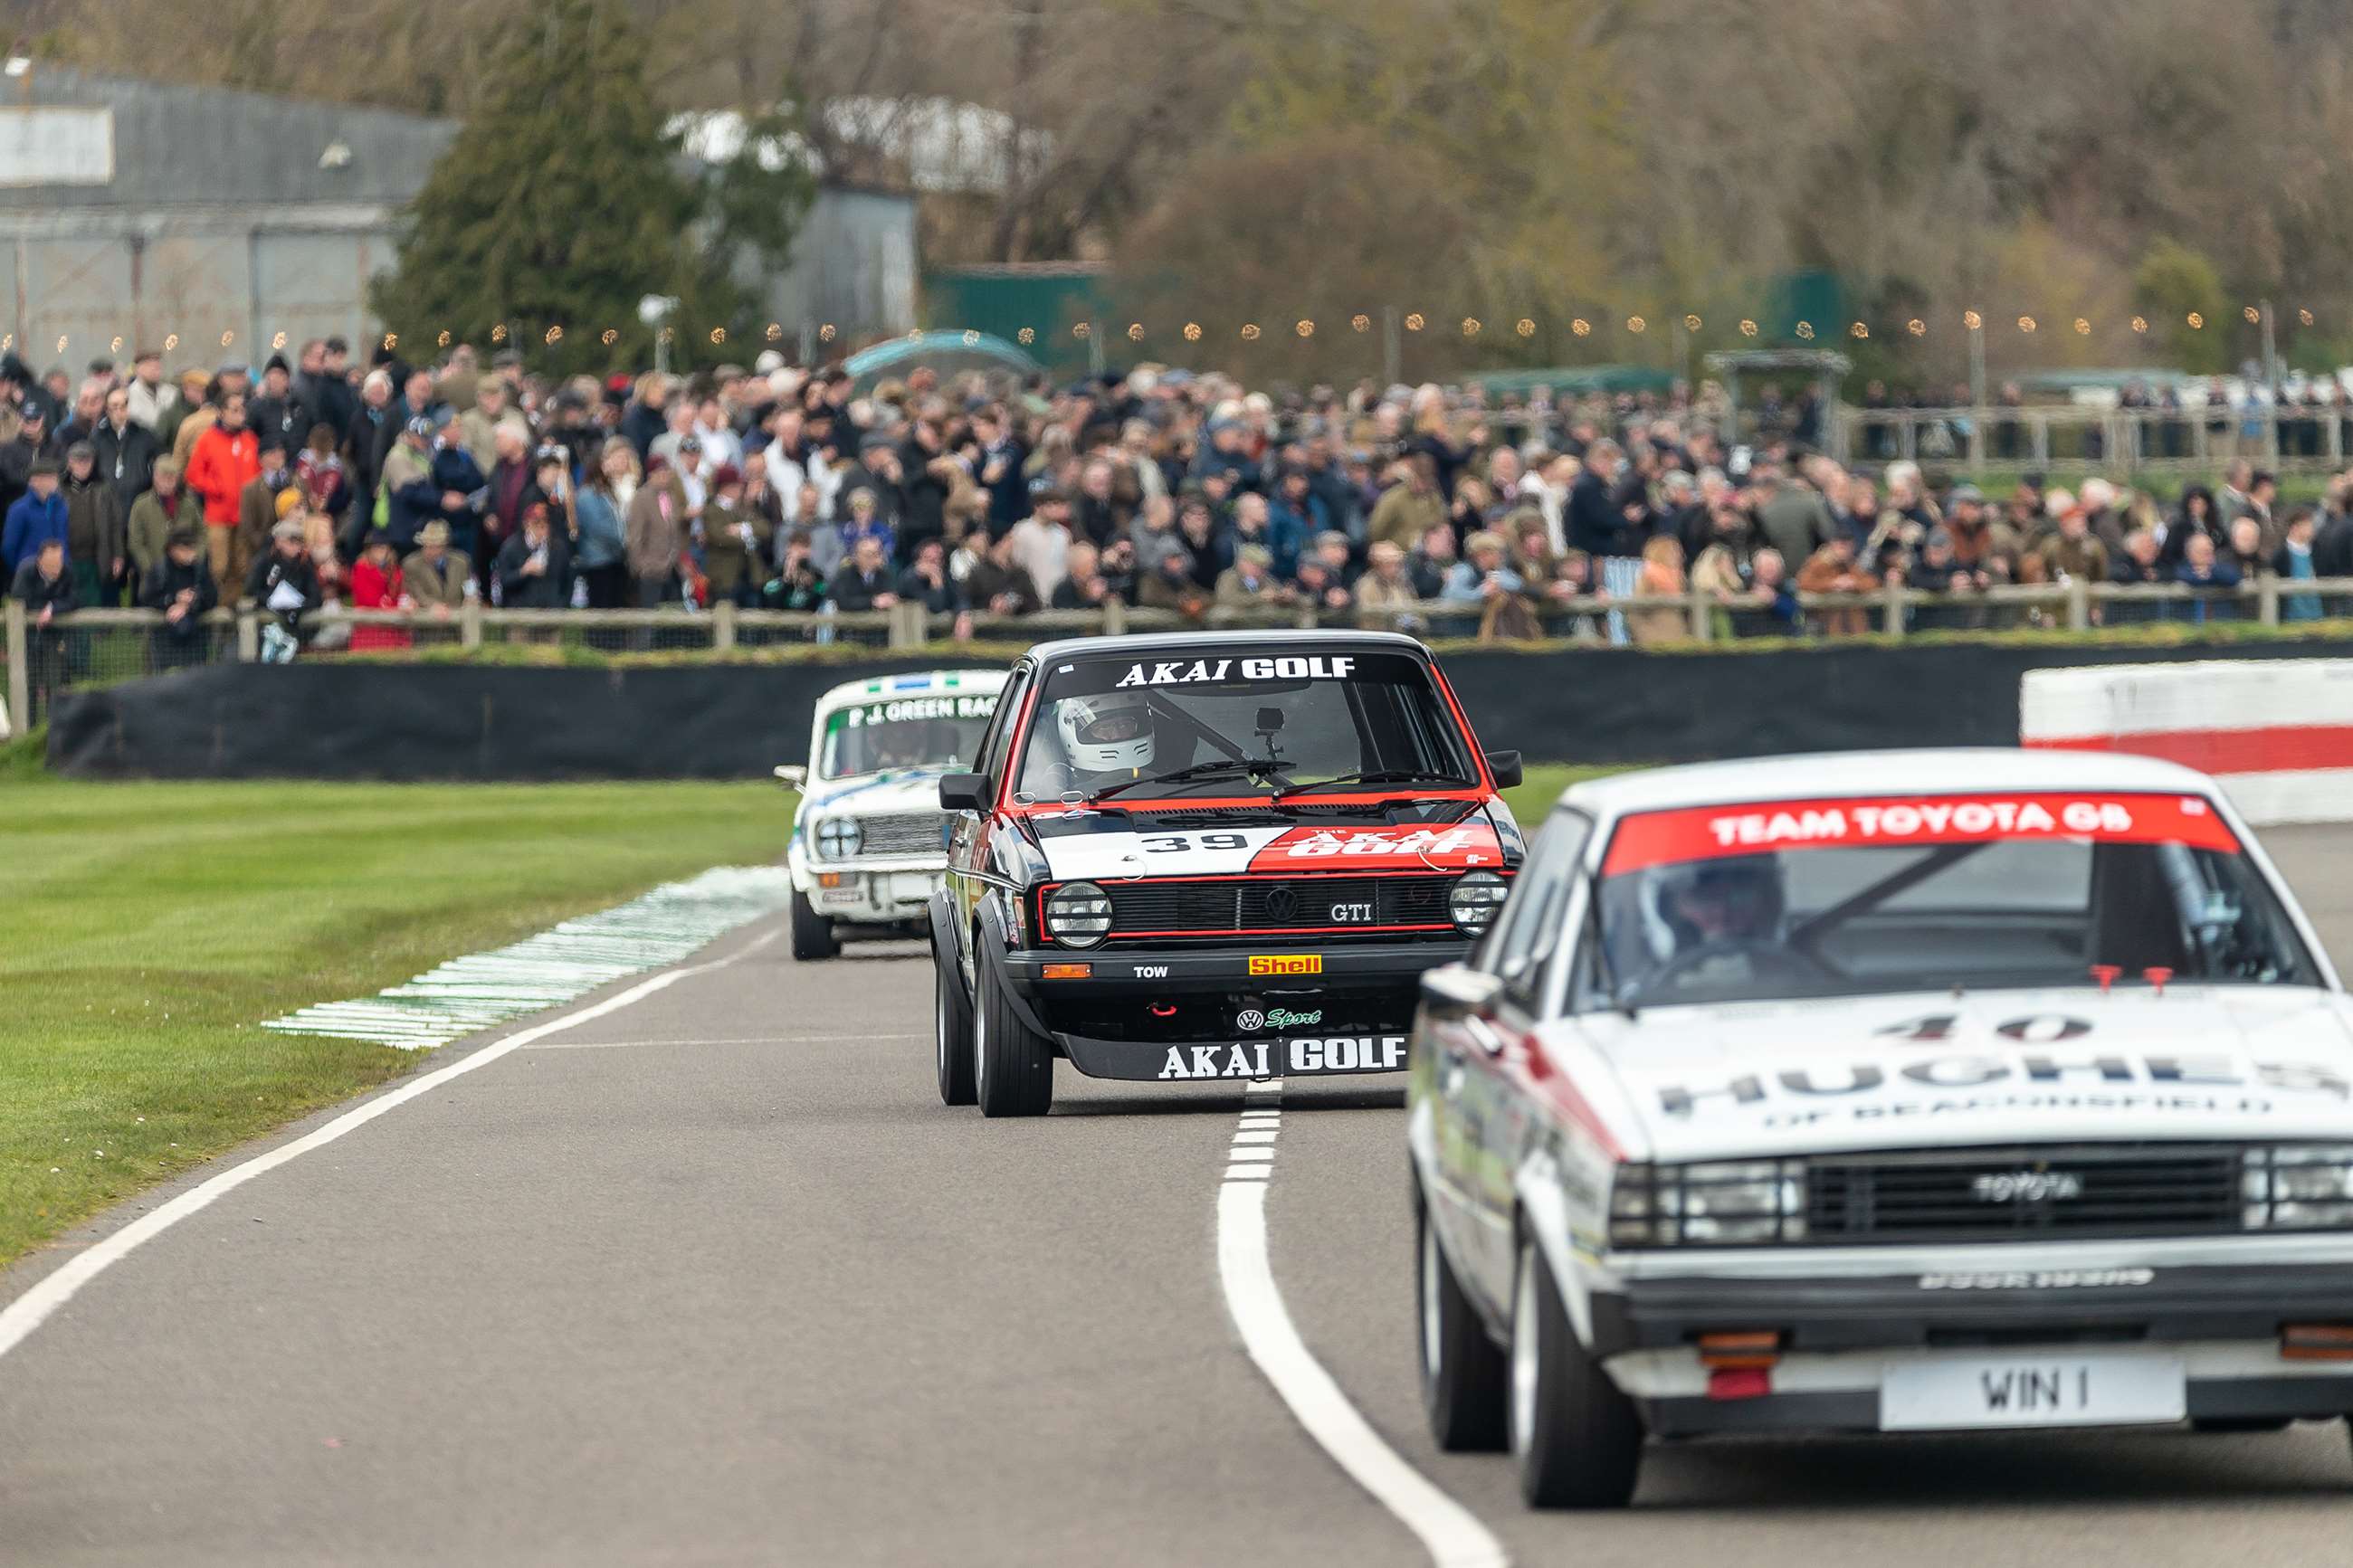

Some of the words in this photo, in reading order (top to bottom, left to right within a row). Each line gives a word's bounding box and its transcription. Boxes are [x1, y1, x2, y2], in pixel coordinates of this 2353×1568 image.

[1116, 660, 1233, 688] AKAI
[1241, 657, 1355, 679] GOLF
[1712, 810, 1845, 845] TEAM
[1853, 803, 2055, 836] TOYOTA
[2062, 803, 2132, 832] GB
[1140, 834, 1249, 853] 39
[1293, 829, 1472, 844] AKAI
[1288, 841, 1472, 857] GOLF
[1331, 904, 1372, 922] GTI
[1134, 966, 1168, 978] TOW
[1252, 958, 1319, 974] Shell
[1264, 1008, 1322, 1030] Sport
[1872, 1014, 2094, 1041] 40
[1157, 1043, 1270, 1079] AKAI
[1290, 1037, 1406, 1070] GOLF
[1980, 1367, 2062, 1411] WIN
